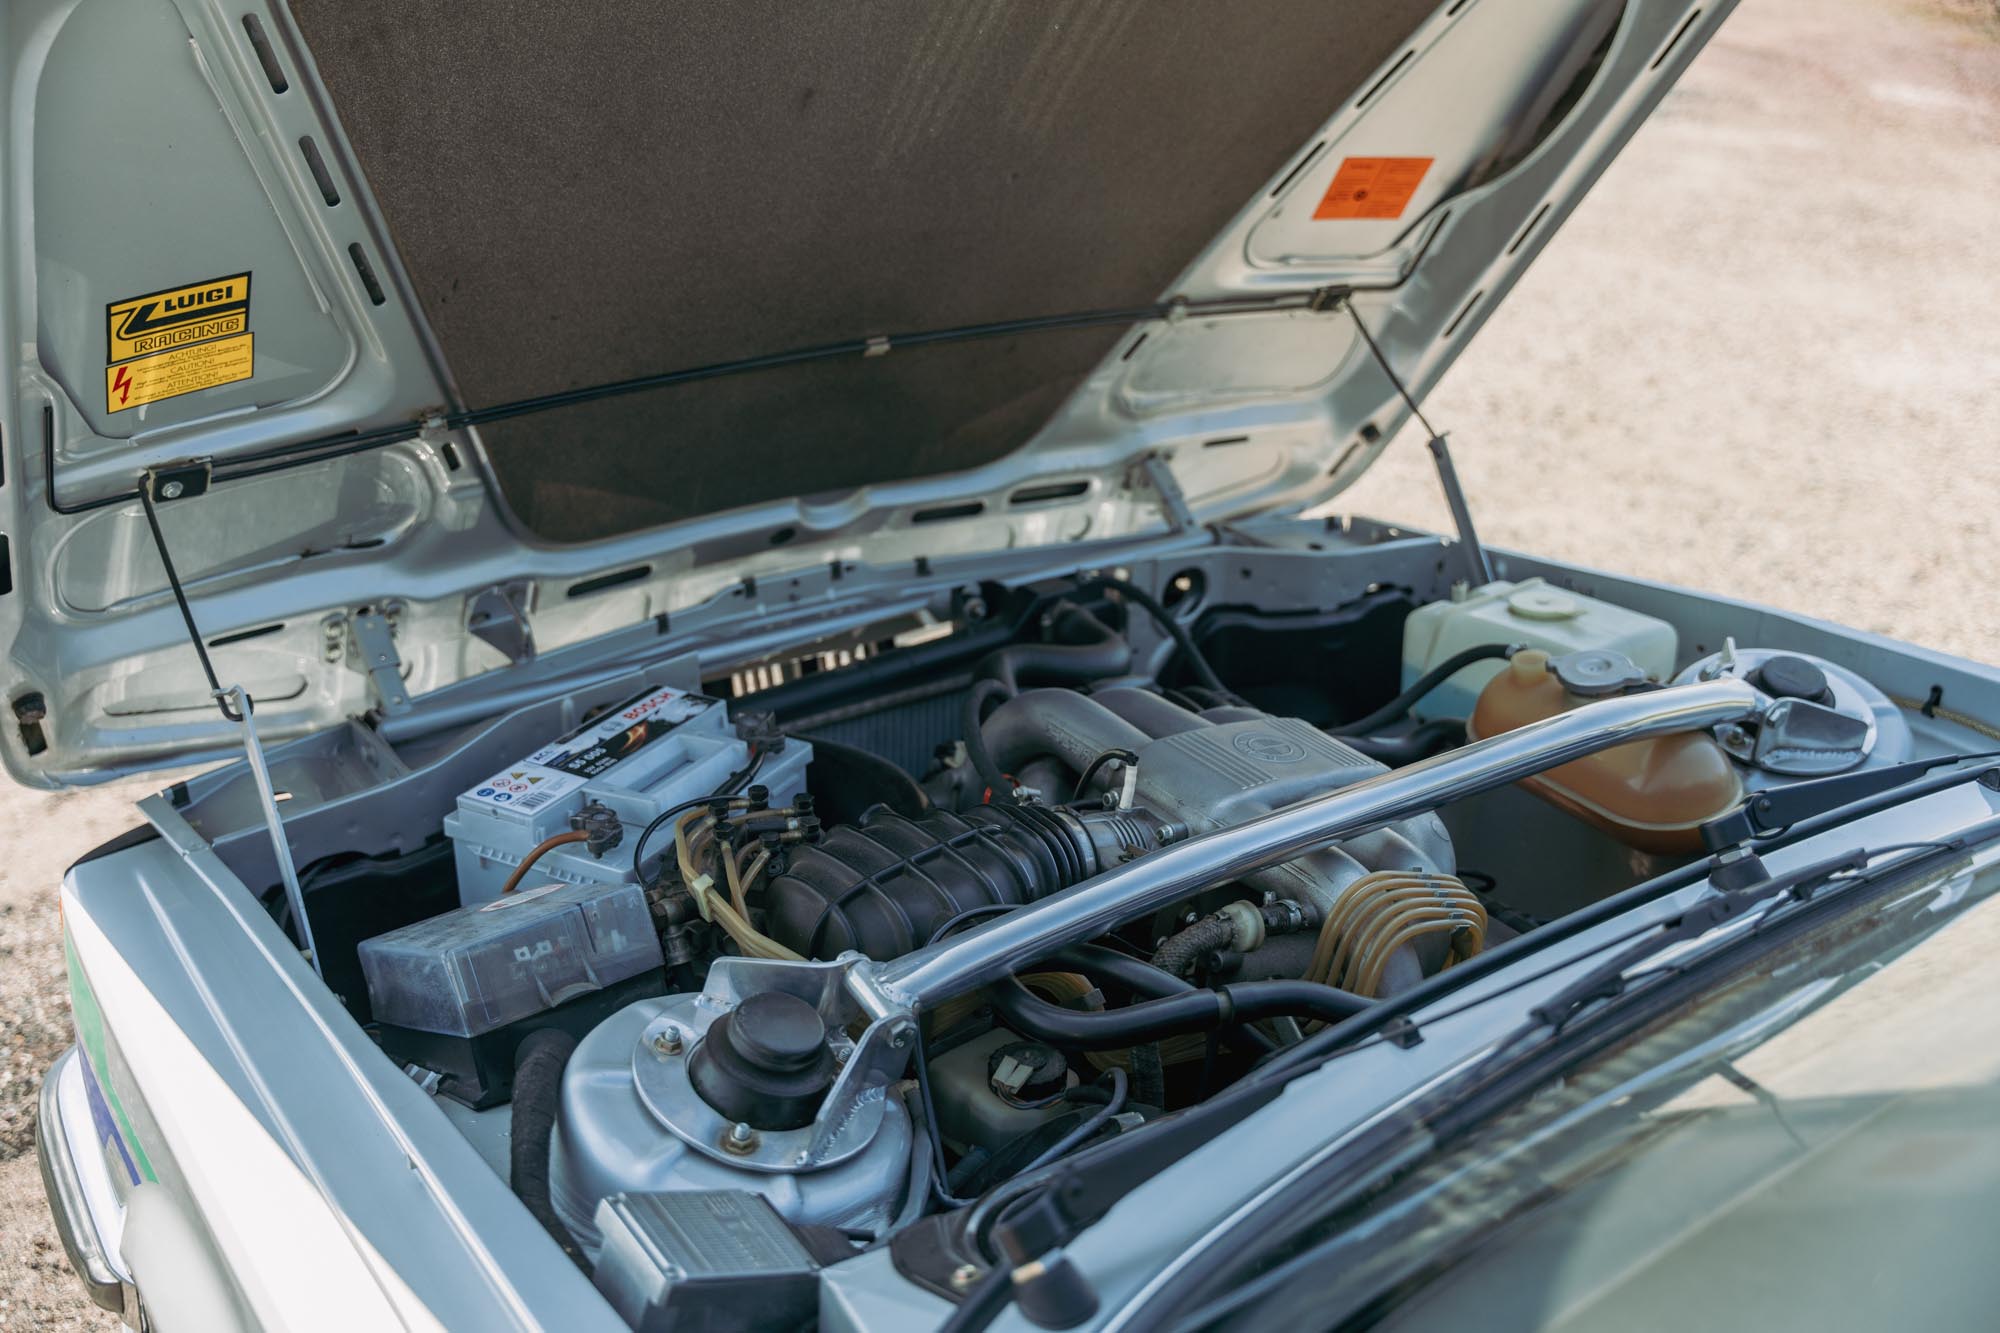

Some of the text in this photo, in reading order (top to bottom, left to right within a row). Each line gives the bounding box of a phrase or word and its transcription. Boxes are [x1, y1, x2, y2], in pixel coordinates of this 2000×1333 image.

[164, 285, 233, 313] LUIGI
[134, 318, 240, 353] RACING
[168, 344, 217, 360] ACHTUNG!
[170, 358, 215, 374] CAUTION!
[166, 371, 219, 389] ATTENTION!
[623, 692, 674, 719] BOSCH
